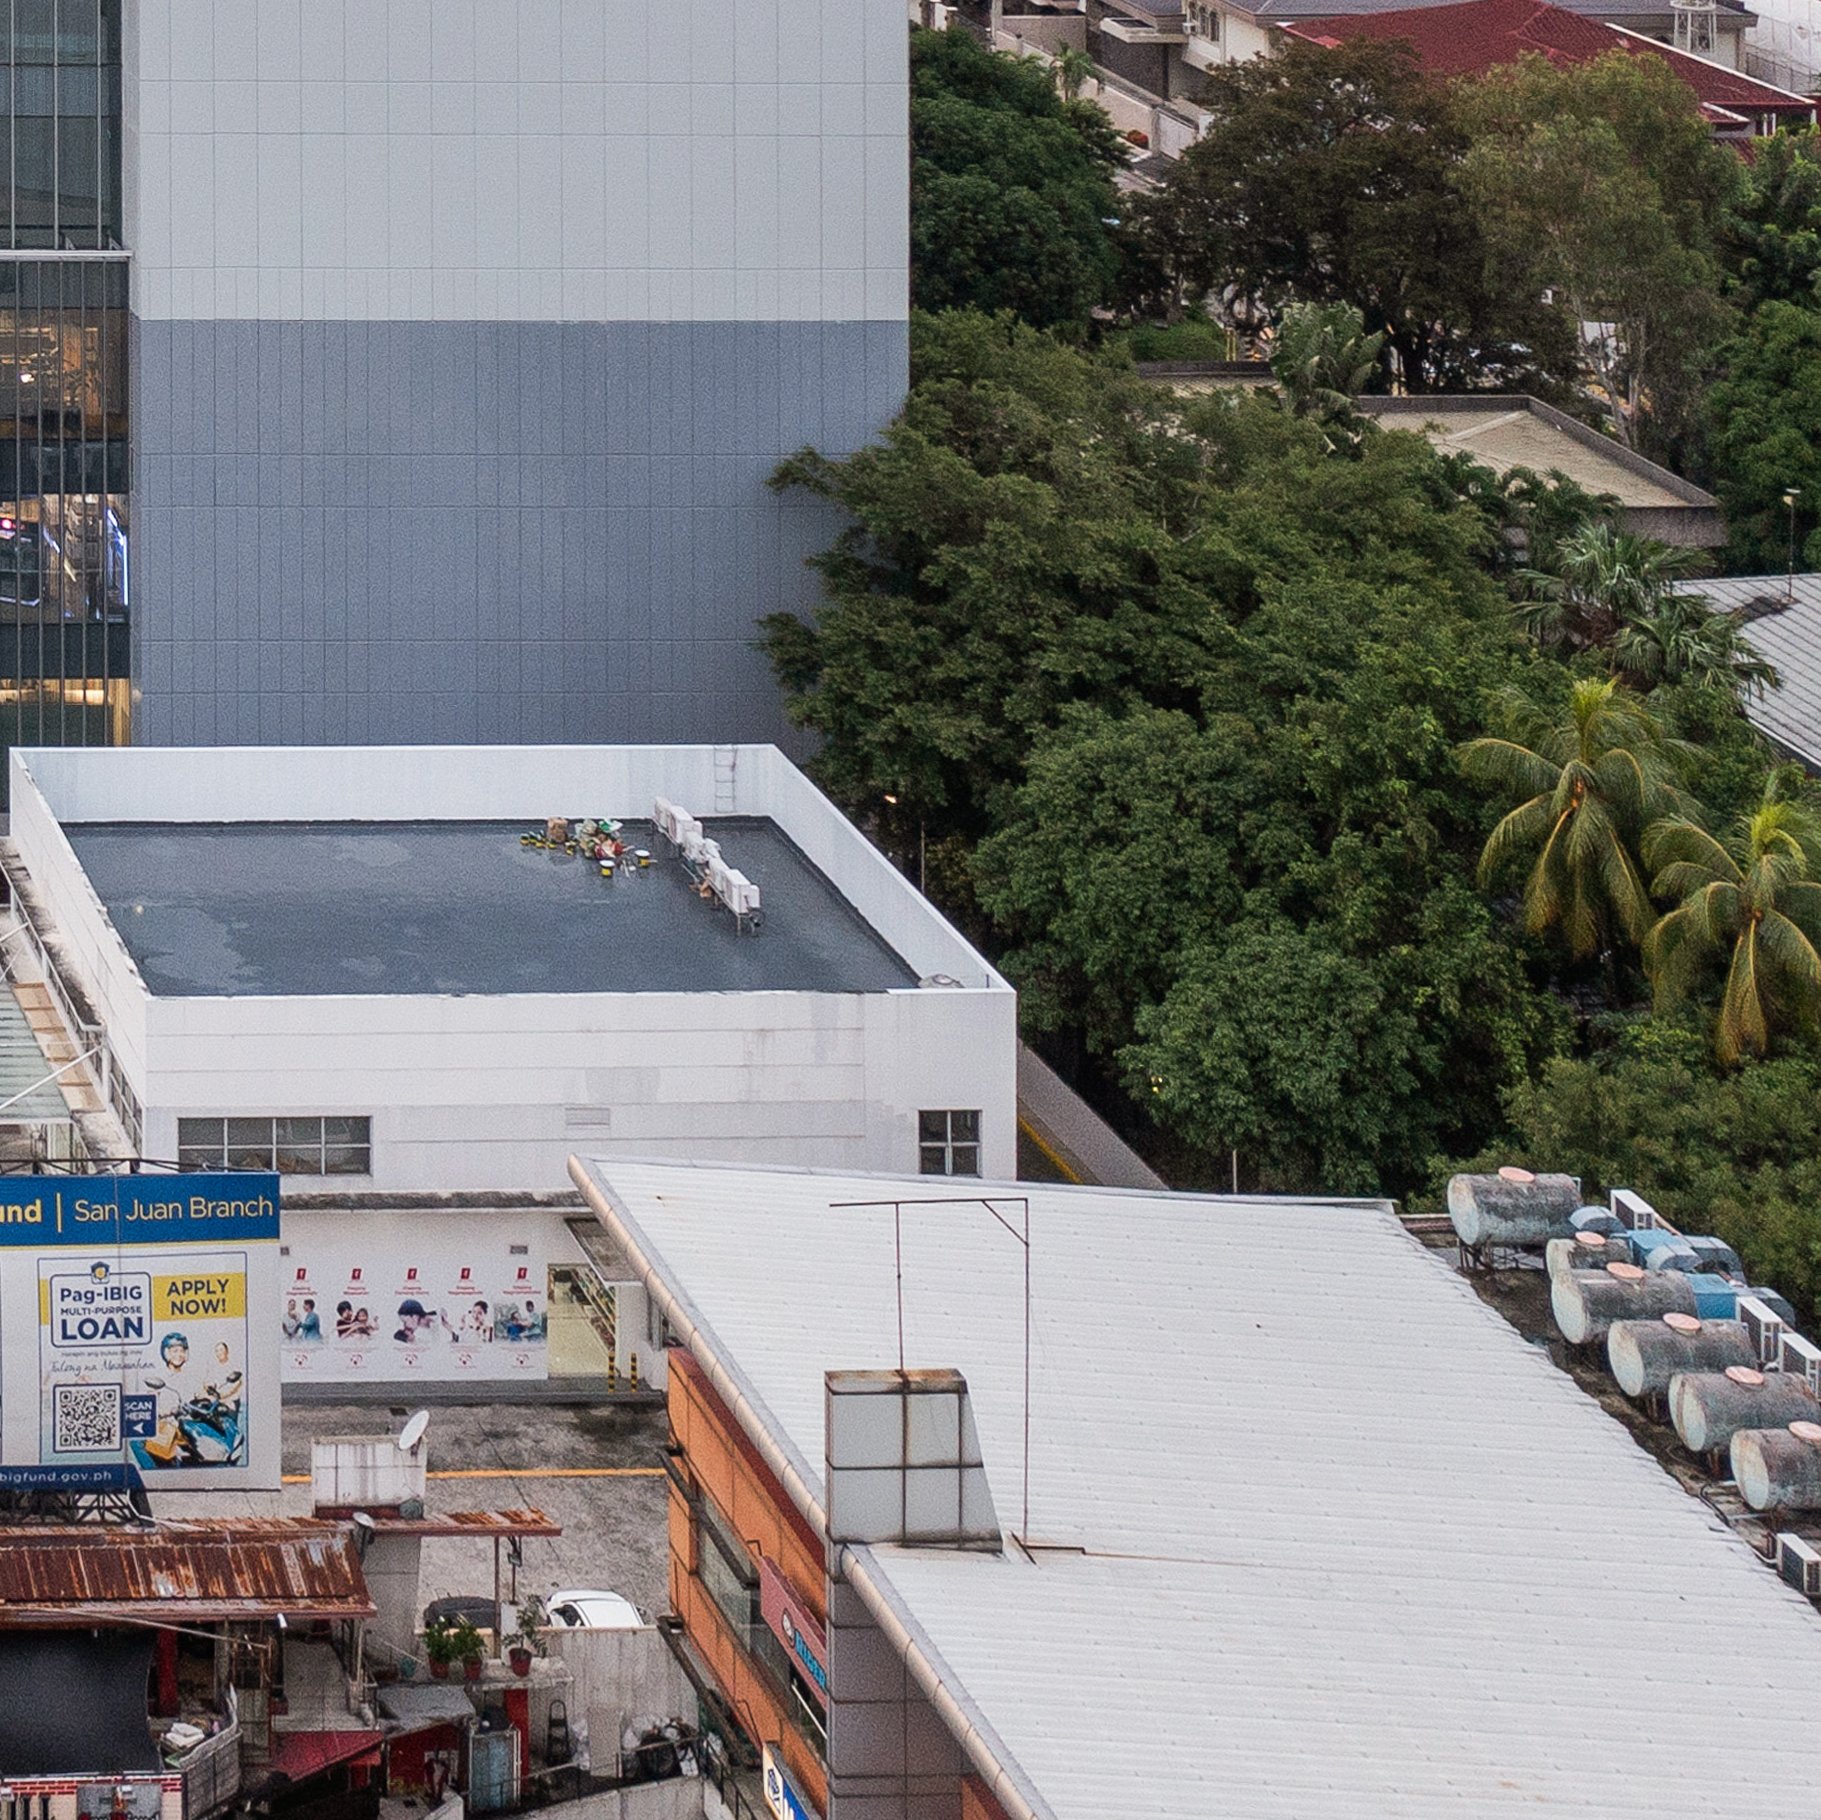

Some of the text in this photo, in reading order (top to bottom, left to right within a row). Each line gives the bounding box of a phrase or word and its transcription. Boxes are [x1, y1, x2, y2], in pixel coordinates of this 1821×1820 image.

[74, 1199, 120, 1222] San
[125, 1198, 182, 1221] Juan
[189, 1194, 274, 1219] Branch
[60, 1286, 143, 1304] Pag-IBIG
[166, 1279, 230, 1297] APPLY
[60, 1306, 143, 1316] MULTI-PURPOSE
[170, 1298, 227, 1316] NOW!
[61, 1316, 144, 1341] LOAN
[123, 1401, 153, 1411] SCAN
[124, 1411, 152, 1421] HERE
